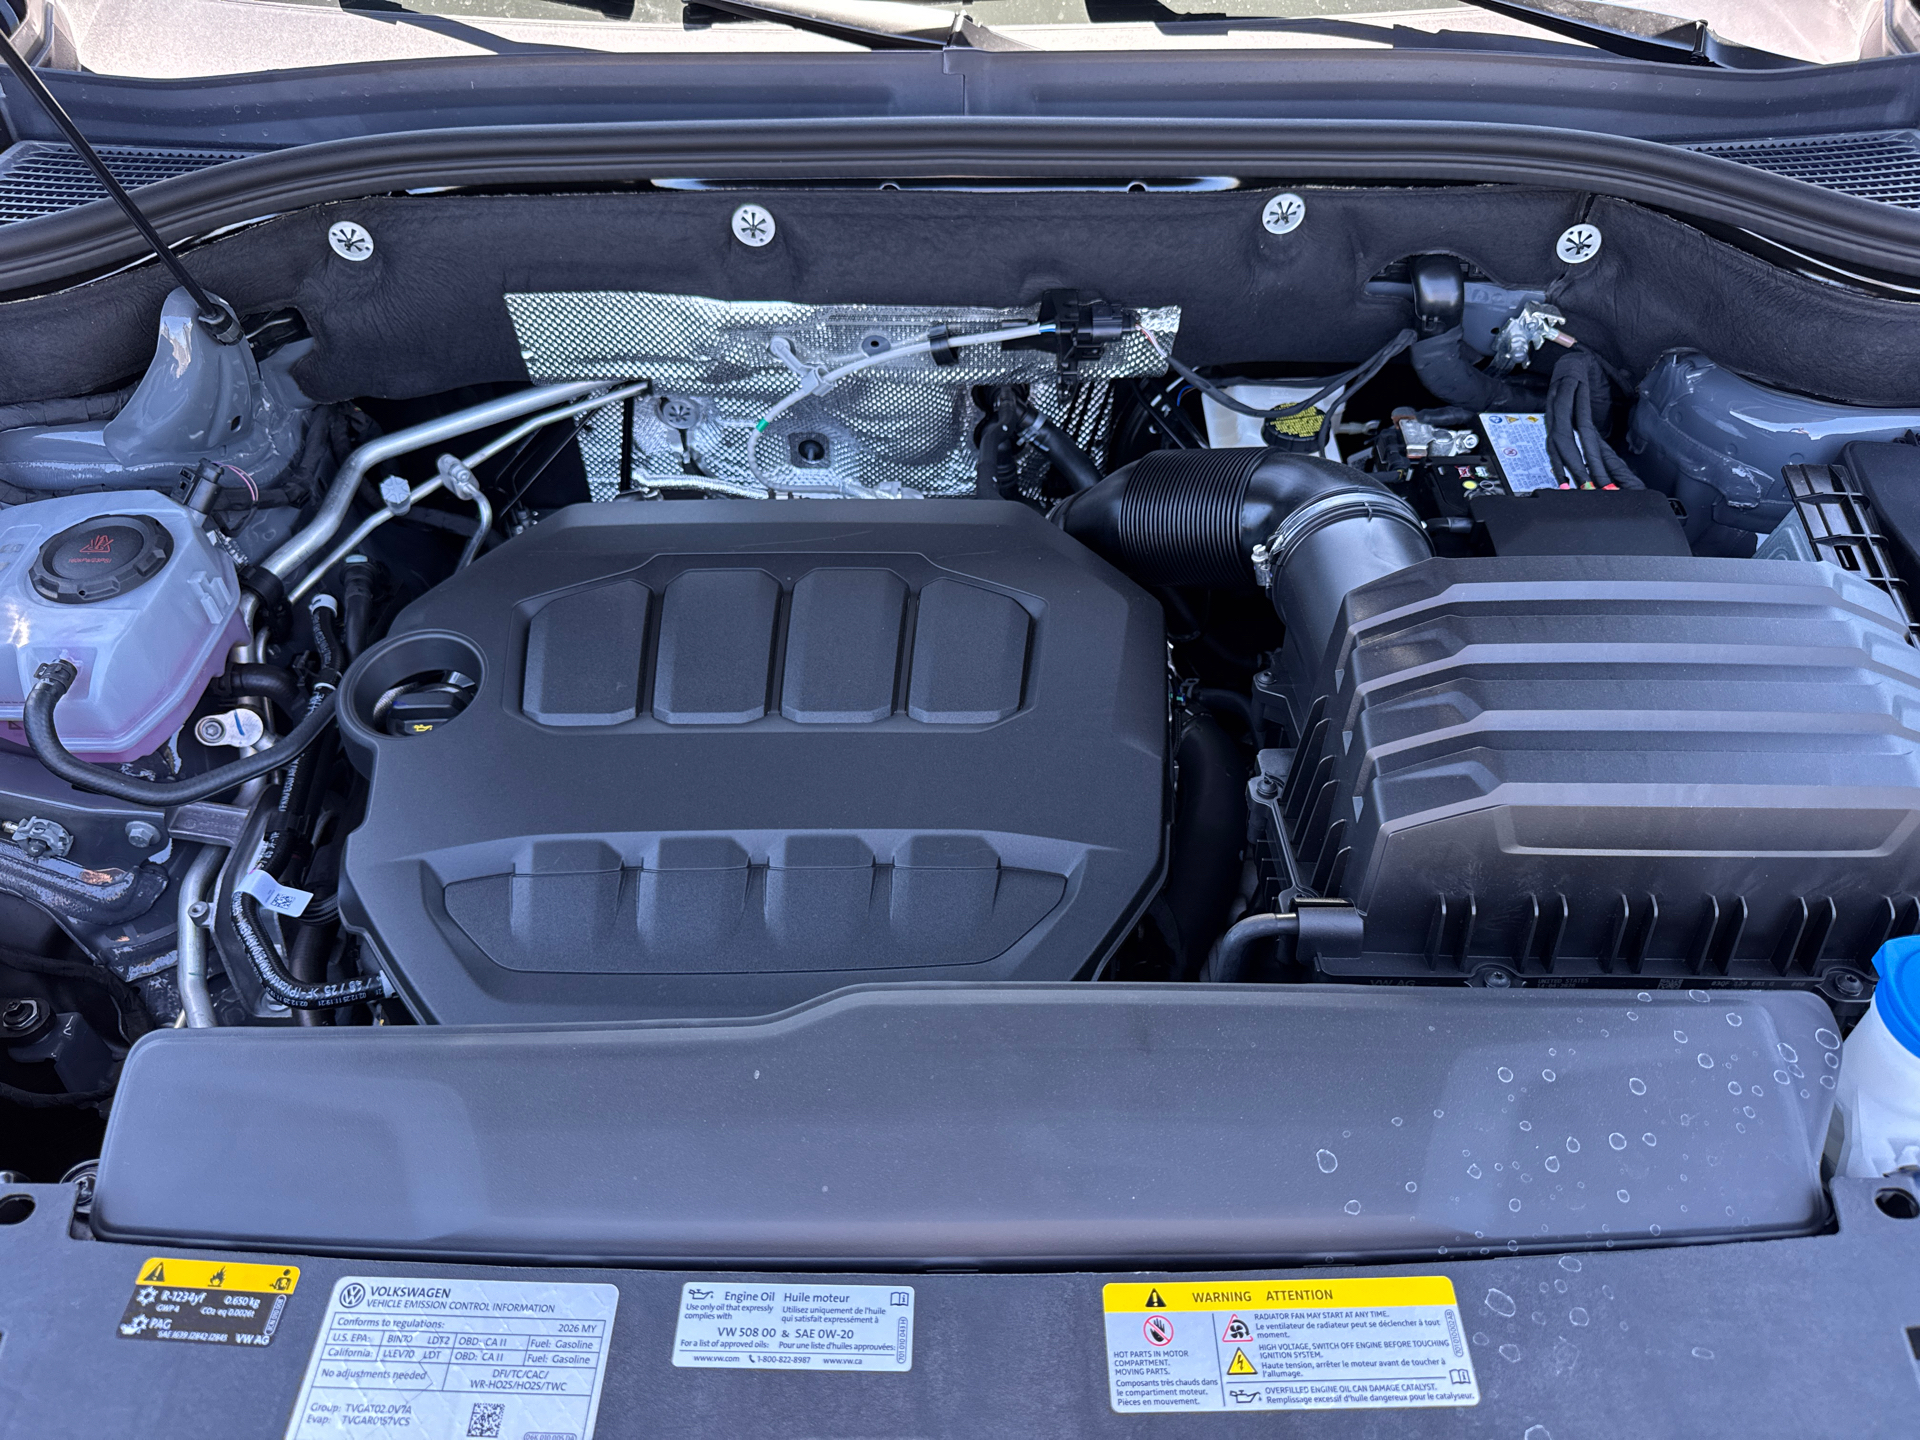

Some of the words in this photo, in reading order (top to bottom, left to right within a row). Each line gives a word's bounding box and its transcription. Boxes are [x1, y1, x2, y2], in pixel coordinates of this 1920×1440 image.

[160, 1289, 207, 1306] R-1234yf
[370, 1286, 451, 1298] VOLKSWAGEN
[724, 1291, 758, 1302] Engine
[760, 1291, 775, 1301] Oil
[783, 1292, 810, 1302] Huile
[812, 1293, 849, 1302] moteur
[1191, 1291, 1251, 1302] WARNING
[1266, 1289, 1333, 1300] ATTENTION
[248, 1296, 260, 1309] kg
[366, 1298, 402, 1308] VEHICLE
[403, 1299, 447, 1309] EMISSION
[448, 1300, 489, 1311] CONTROL
[492, 1302, 555, 1312] INFORMATION
[699, 1302, 715, 1312] only
[715, 1303, 725, 1311] oil
[725, 1303, 740, 1311] that
[740, 1304, 773, 1313] expressly
[782, 1305, 808, 1313] Utilisez
[809, 1306, 853, 1315] uniquement
[853, 1306, 863, 1314] de
[864, 1306, 886, 1314] l'huile
[1253, 1312, 1289, 1320] RADIATOR
[1354, 1310, 1368, 1318] ANY
[684, 1311, 715, 1321] complies
[780, 1314, 793, 1323] qui
[794, 1314, 822, 1322] satisfait
[874, 1315, 878, 1323] à
[148, 1317, 172, 1329] PAG
[336, 1316, 379, 1326] Conforms
[381, 1318, 391, 1327] to
[392, 1318, 444, 1329] regulations:
[557, 1323, 579, 1332] 2026
[580, 1324, 597, 1333] MY
[1255, 1322, 1264, 1330] Le
[1305, 1321, 1315, 1329] de
[1350, 1321, 1367, 1329] peut
[1378, 1319, 1416, 1327] déclencher
[1418, 1318, 1423, 1326] à
[332, 1332, 348, 1342] U.S.
[717, 1326, 737, 1336] VW
[738, 1327, 759, 1337] 508
[761, 1327, 776, 1337] 00
[781, 1329, 789, 1338] &
[794, 1328, 815, 1338] SAE
[817, 1328, 854, 1339] 0W-20
[235, 1332, 254, 1344] VW
[253, 1334, 269, 1345] AG
[458, 1336, 482, 1346] OBD:
[483, 1337, 497, 1346] CA
[530, 1338, 551, 1348] Fuel:
[554, 1339, 593, 1349] Gasoline
[680, 1338, 692, 1346] For
[698, 1339, 710, 1347] list
[710, 1339, 719, 1347] of
[719, 1339, 753, 1349] approved
[754, 1340, 769, 1348] oils:
[778, 1340, 795, 1348] Pour
[810, 1341, 825, 1349] liste
[825, 1341, 852, 1350] d'huiles
[853, 1342, 895, 1351] approuvées:
[1277, 1342, 1311, 1350] VOLTAGE,
[1340, 1341, 1354, 1349] OFF
[1355, 1341, 1382, 1349] ENGINE
[1383, 1340, 1411, 1348] BEFORE
[1411, 1339, 1449, 1347] TOUCHING
[327, 1347, 373, 1357] California:
[420, 1350, 441, 1360] LDT
[454, 1351, 477, 1360] OBD:
[481, 1352, 494, 1361] CA
[1113, 1350, 1128, 1358] HOT
[1162, 1349, 1188, 1357] MOTOR
[1259, 1351, 1292, 1359] IGNITION
[1293, 1350, 1323, 1358] SYSTEM.
[526, 1353, 548, 1363] Fuel:
[551, 1354, 590, 1364] Gasoline
[756, 1355, 811, 1363] 1-800-822-8987
[1113, 1358, 1170, 1366] COMPARTMENT.
[1260, 1361, 1283, 1369] Haute
[1284, 1360, 1314, 1369] tension,
[1315, 1360, 1340, 1368] arrêter
[1400, 1358, 1410, 1366] de
[1410, 1357, 1439, 1366] toucher
[1440, 1357, 1446, 1365] à
[321, 1368, 334, 1377] No
[335, 1368, 390, 1380] adjustments
[392, 1370, 427, 1382] needed
[491, 1368, 549, 1379] DFI/TC/CAC/
[1114, 1367, 1144, 1375] MOVING
[1262, 1369, 1303, 1378] l'allumage.
[1115, 1379, 1159, 1388] Composants
[1159, 1378, 1174, 1386] très
[1174, 1378, 1200, 1386] chauds
[1200, 1377, 1218, 1385] dans
[1264, 1385, 1309, 1394] OVERFILLED
[1309, 1385, 1338, 1393] ENGINE
[1338, 1385, 1352, 1393] OIL
[1351, 1384, 1368, 1392] CAN
[1368, 1383, 1400, 1392] DAMAGE
[1400, 1382, 1437, 1391] CATALYST.
[1116, 1388, 1123, 1396] le
[1124, 1388, 1177, 1397] compartiment
[1265, 1395, 1312, 1405] Remplissage
[1313, 1394, 1341, 1403] excessif
[1343, 1393, 1368, 1402] d'huile
[1369, 1393, 1408, 1403] dangereux
[1408, 1394, 1425, 1402] pour
[1426, 1392, 1434, 1400] le
[1435, 1391, 1474, 1401] catalyseur.
[1153, 1397, 1200, 1405] mouvement.
[309, 1402, 341, 1414] Group:
[305, 1413, 331, 1425] Evap:
